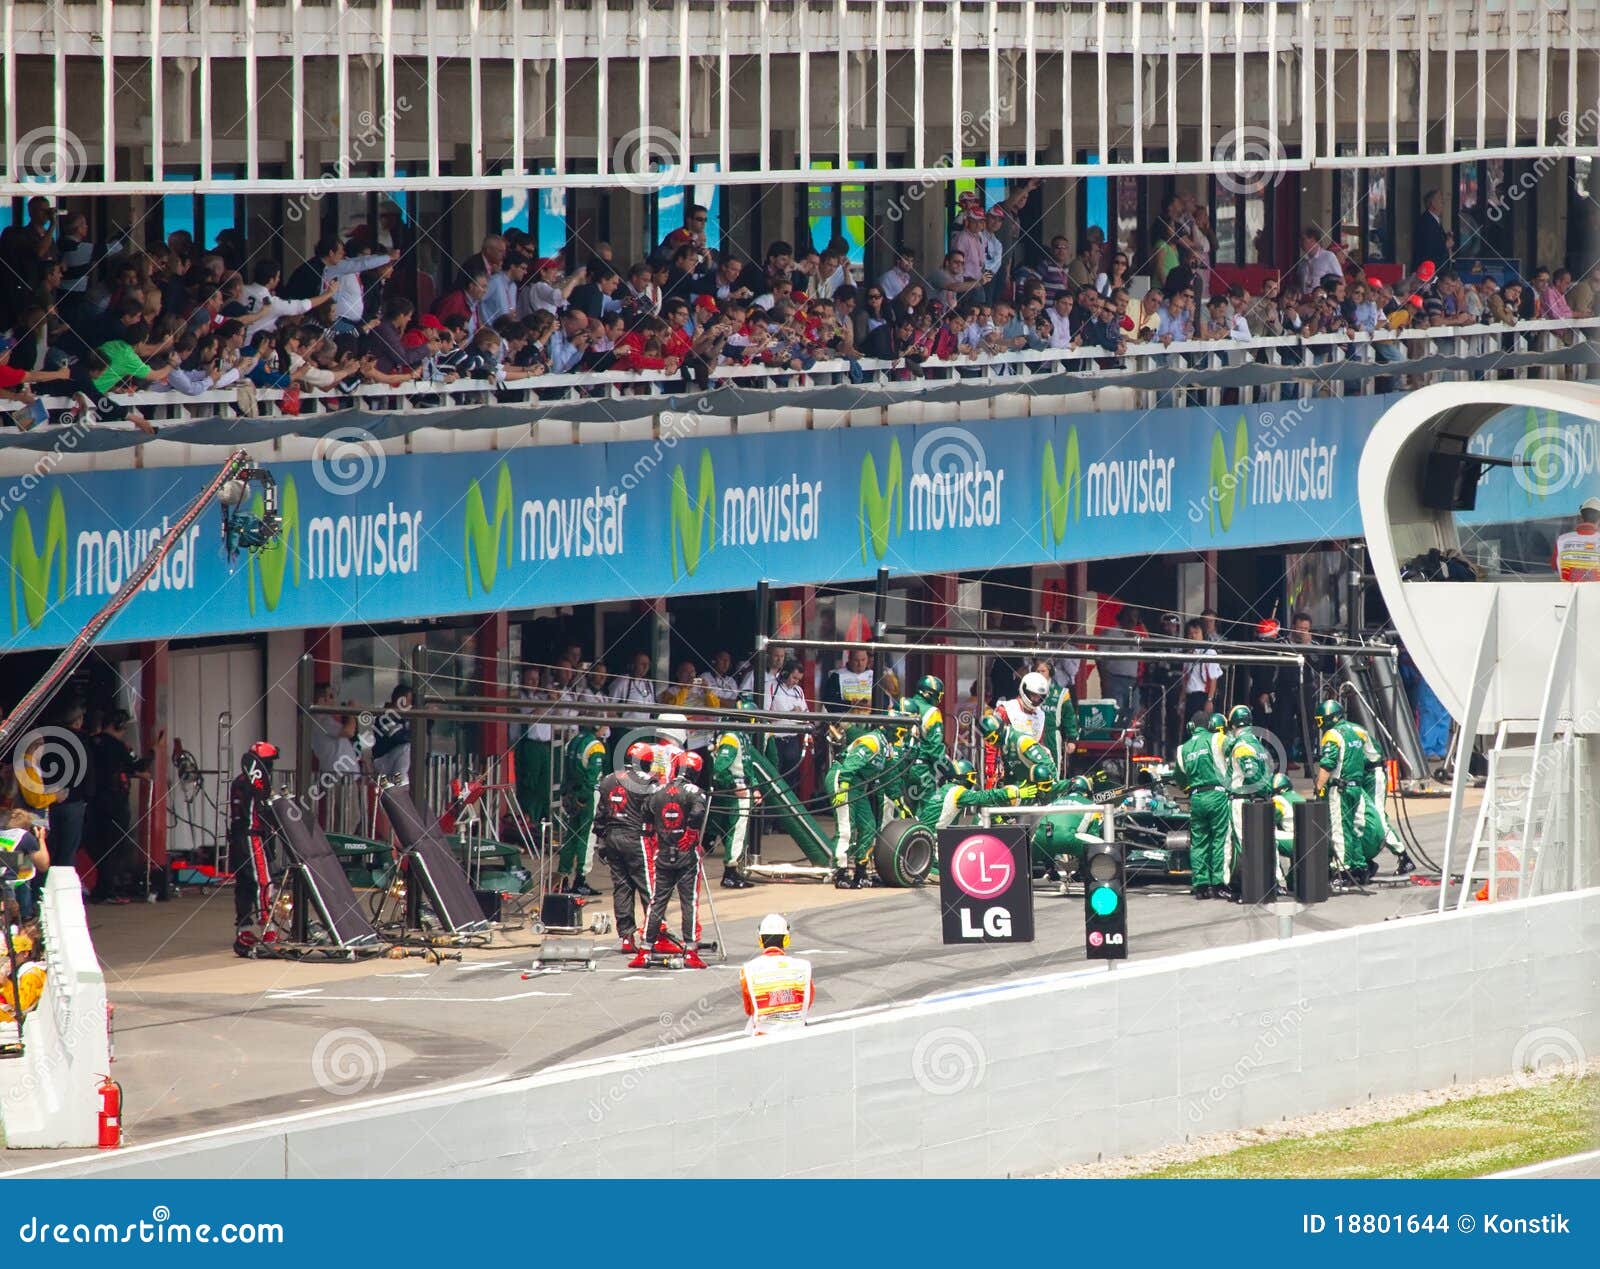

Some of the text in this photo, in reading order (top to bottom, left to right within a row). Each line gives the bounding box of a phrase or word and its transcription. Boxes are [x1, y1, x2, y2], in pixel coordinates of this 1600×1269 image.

[909, 460, 1004, 531] movistar
[1087, 449, 1175, 517] movistar
[1252, 437, 1337, 505] movistar
[308, 501, 423, 580] movistar
[521, 485, 627, 562] movistar
[722, 473, 822, 546] movistar
[960, 906, 1012, 938] LG
[1105, 933, 1123, 945] LG
